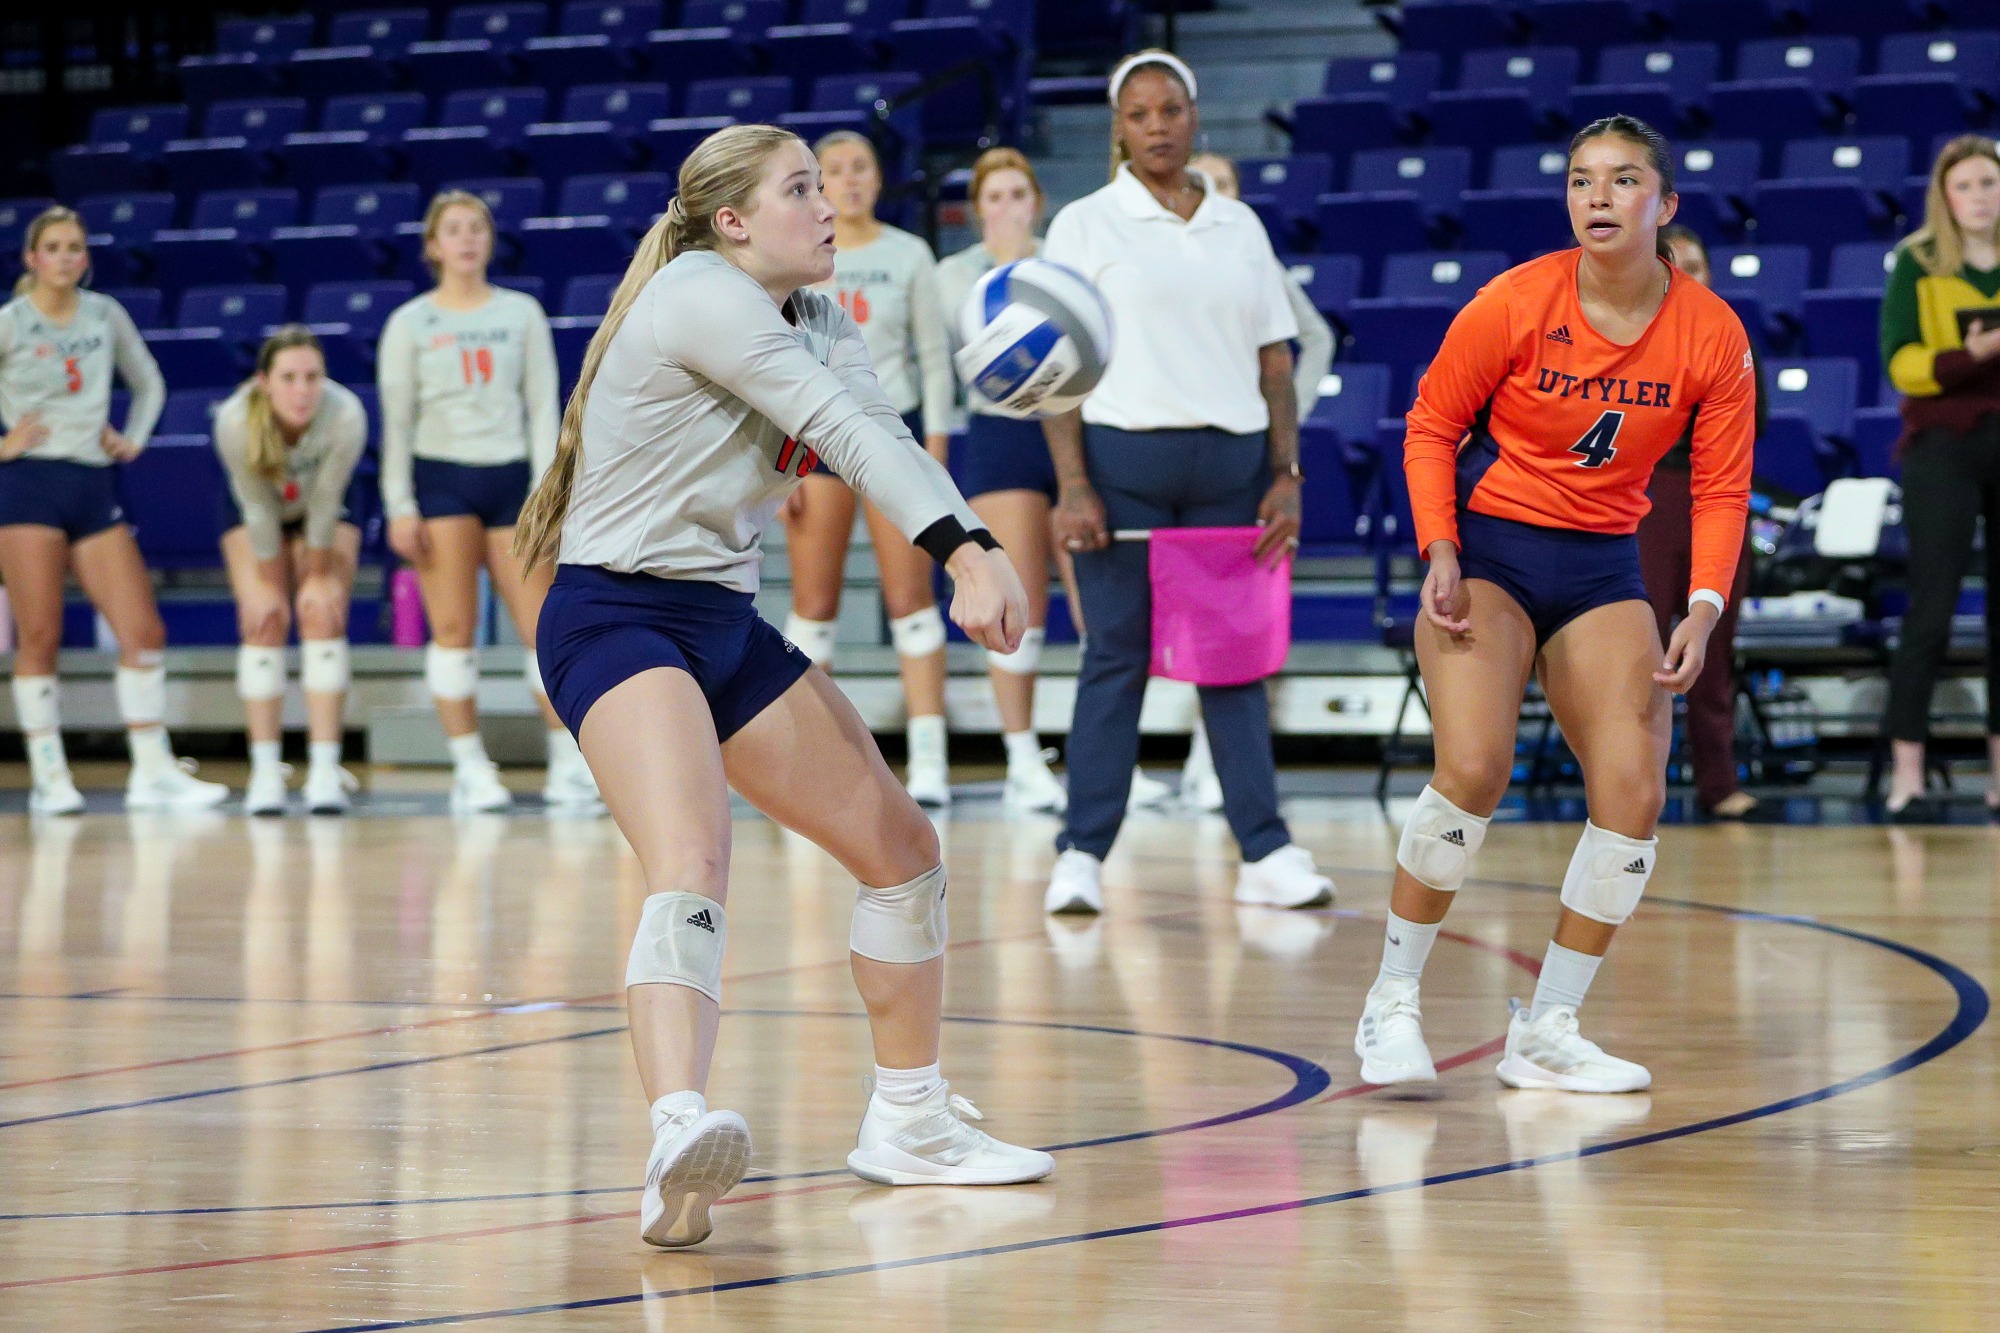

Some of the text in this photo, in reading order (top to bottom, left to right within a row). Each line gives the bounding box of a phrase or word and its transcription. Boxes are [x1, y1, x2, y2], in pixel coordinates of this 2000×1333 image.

[1546, 333, 1574, 346] adidas
[65, 357, 83, 393] 5
[461, 347, 493, 386] 19
[1567, 409, 1625, 468] 4
[686, 917, 715, 934] adidas
